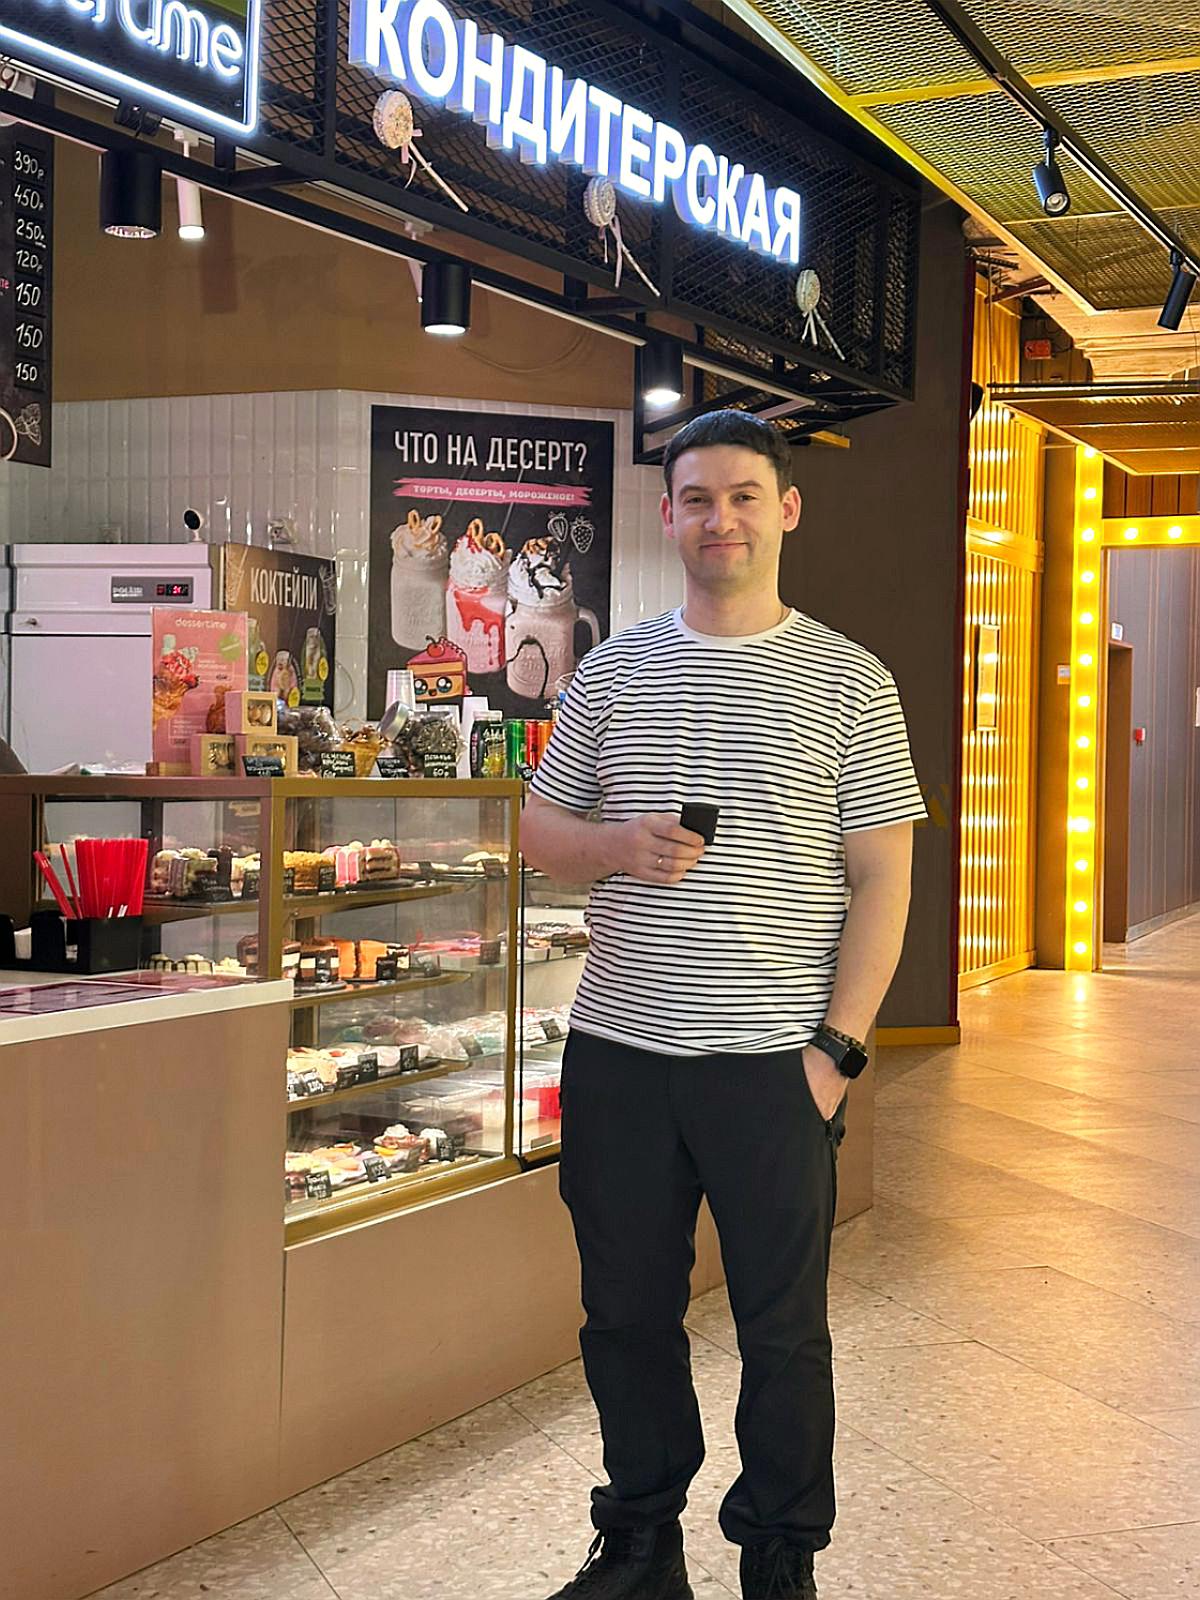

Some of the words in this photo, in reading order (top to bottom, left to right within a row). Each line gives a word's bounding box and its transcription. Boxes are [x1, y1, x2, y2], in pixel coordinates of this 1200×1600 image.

[356, 0, 802, 264] КОНДИТЕРСКАЯ
[16, 282, 41, 306] 150
[16, 322, 43, 348] 150
[15, 362, 38, 381] 150
[394, 431, 438, 464] ЧТО
[447, 434, 478, 467] НА
[485, 437, 588, 473] ДЕСЕРТ?
[413, 484, 453, 497] ТОРТЫ,
[455, 486, 506, 500] ДЕСЕРТЫ,
[509, 490, 575, 502] МОРОЖЕНОЕ!
[250, 566, 318, 610] КОКТЕЙЛИ
[175, 617, 227, 630] dessertime
